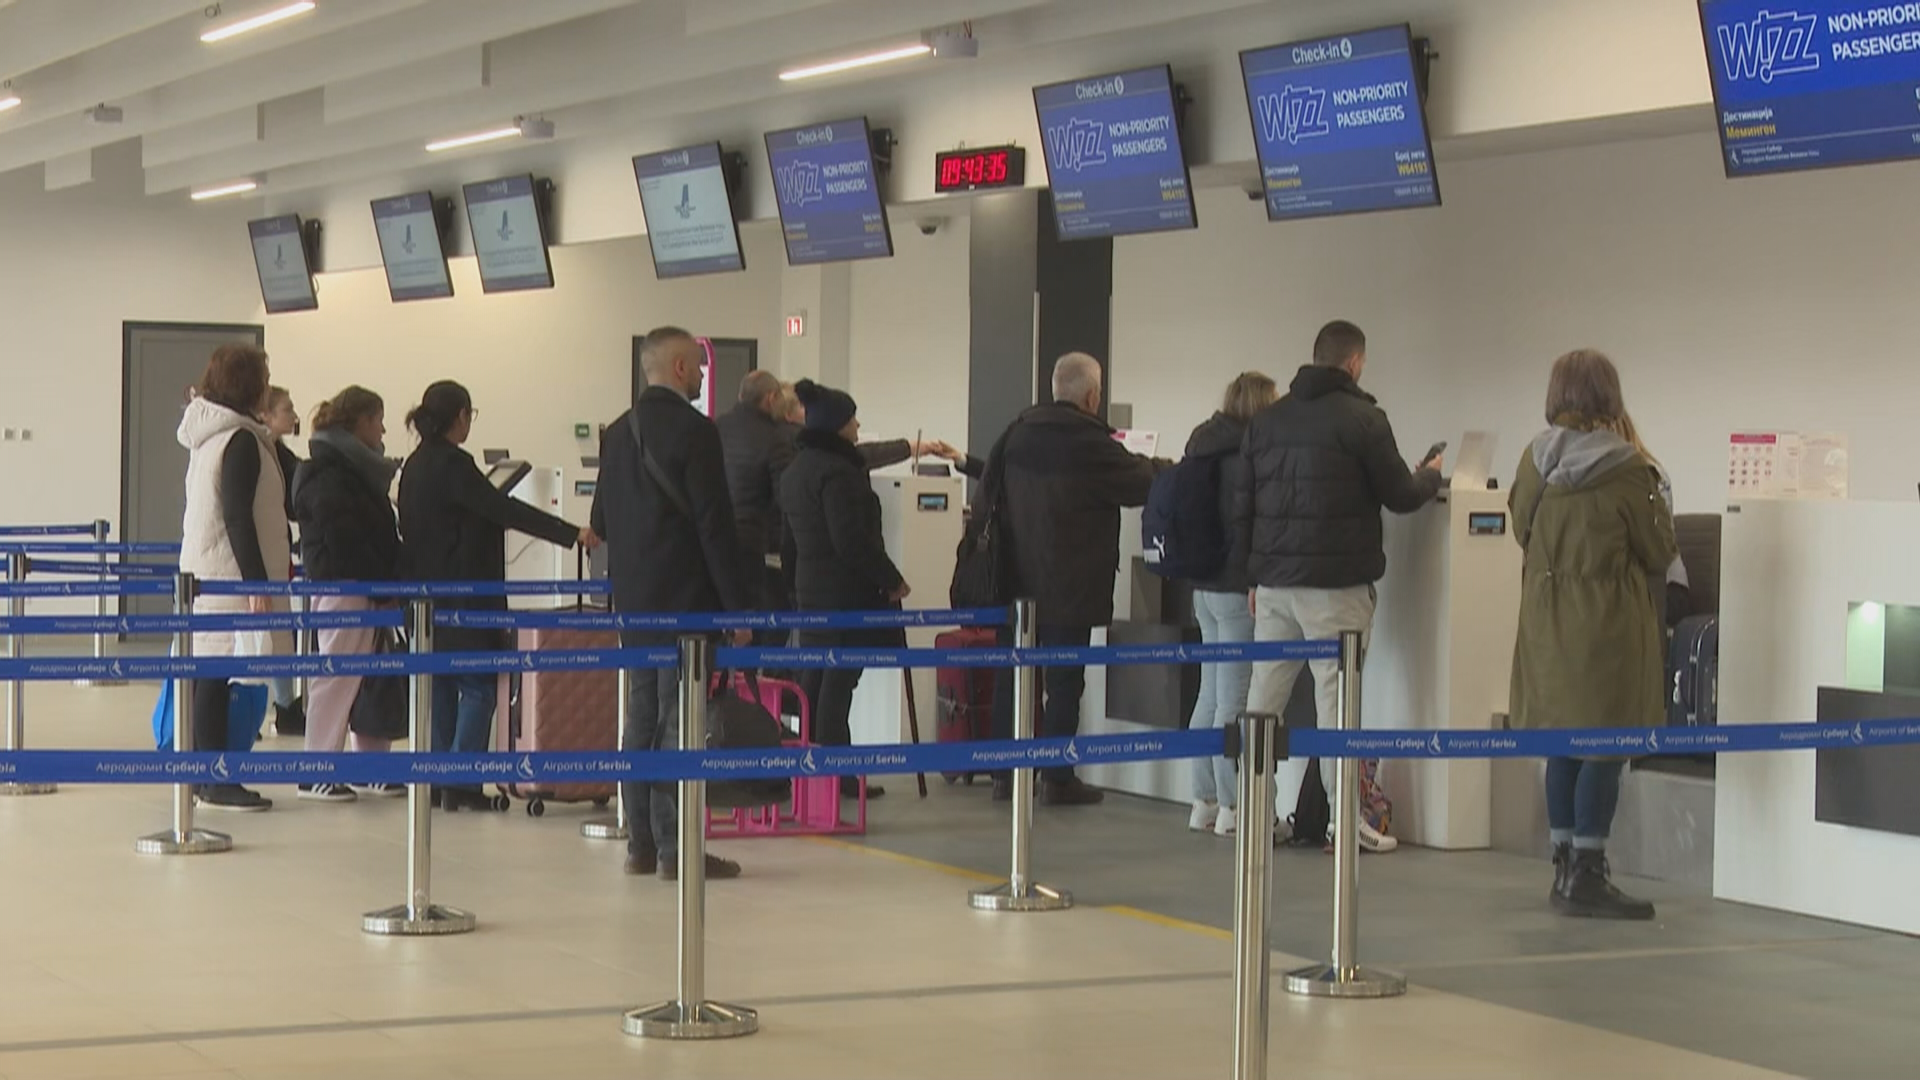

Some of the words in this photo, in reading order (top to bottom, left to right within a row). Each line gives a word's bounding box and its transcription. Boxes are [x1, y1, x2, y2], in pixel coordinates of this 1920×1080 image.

[1828, 2, 1920, 34] NON-PRIORI
[1292, 41, 1340, 65] Check-in
[1832, 31, 1920, 61] PASSENGER
[1075, 80, 1115, 100] Check-in
[1333, 81, 1409, 107] NON-PRIORITY
[1336, 105, 1405, 129] PASSENGERS
[1108, 115, 1170, 137] NON-PRIORITY
[1112, 135, 1168, 157] PASSENGERS
[822, 159, 869, 178] NON-PRIORITY
[940, 151, 1009, 187] 09:43:35
[826, 178, 868, 196] PASSENGERS
[1395, 738, 1425, 749] Србије
[1448, 738, 1479, 748] Airports
[1481, 737, 1490, 747] of
[1491, 738, 1517, 748] Serbia
[1616, 736, 1643, 746] Србије
[1664, 735, 1694, 745] Airports
[1696, 734, 1704, 743] of
[1705, 734, 1729, 744] Serbia
[972, 750, 1025, 762] Аеродроми
[1027, 748, 1060, 760] Србије
[1087, 744, 1122, 755] Airports
[1124, 743, 1133, 752] of
[1134, 742, 1163, 752] Serbia
[239, 761, 282, 773] Airports
[286, 761, 297, 771] of
[299, 761, 335, 772] Serbia
[543, 761, 583, 772] Airports
[587, 760, 597, 771] of
[598, 760, 632, 771] Serbia
[701, 758, 759, 770] Аеродроми
[760, 757, 797, 769] Србије
[824, 755, 862, 766] Airports
[864, 754, 874, 764] of
[875, 754, 907, 764] Serbia
[96, 762, 163, 775] Аеродроми
[165, 762, 206, 775] Србије
[411, 761, 473, 774] Аеродроми
[474, 761, 513, 774] Србије
